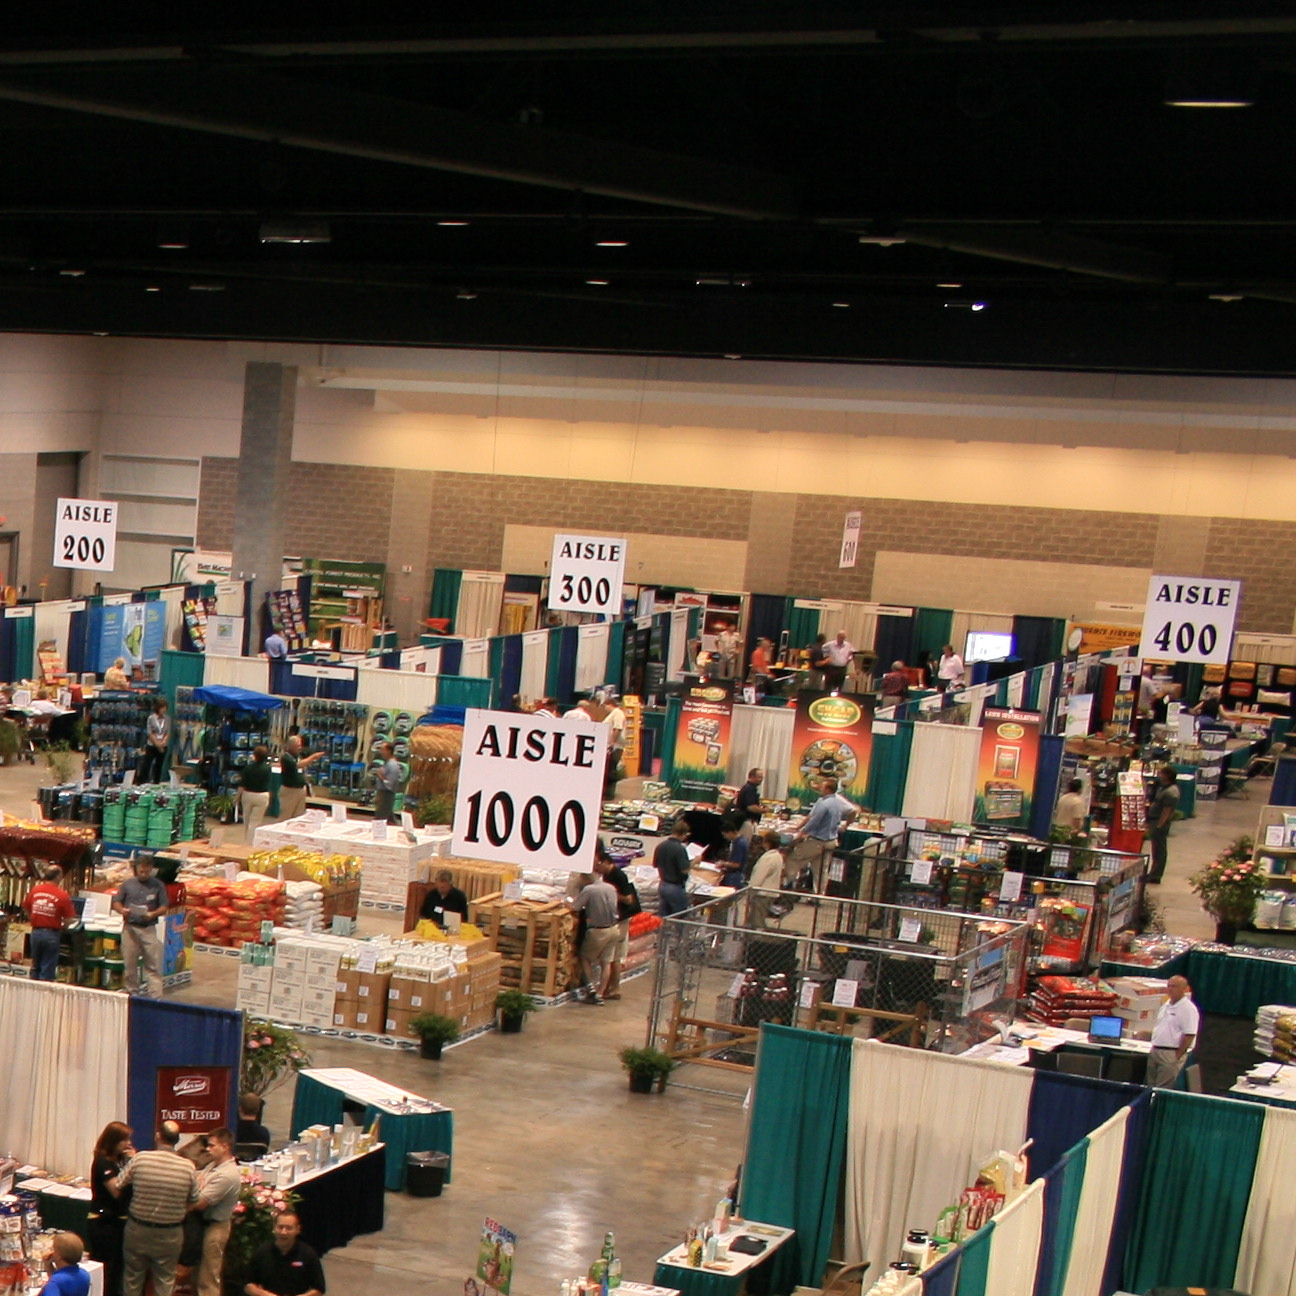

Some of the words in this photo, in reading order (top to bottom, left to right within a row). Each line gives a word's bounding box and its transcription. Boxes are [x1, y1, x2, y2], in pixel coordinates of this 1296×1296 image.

[62, 504, 113, 524] AISLE
[63, 535, 106, 563] 200
[560, 541, 619, 562] AISLE
[560, 574, 610, 606] 300
[1156, 584, 1231, 607] AISLE
[1154, 621, 1217, 656] 400
[476, 724, 596, 768] AISLE
[465, 789, 586, 857] 1000
[161, 1109, 187, 1120] TASTE
[190, 1109, 221, 1120] TESTED
